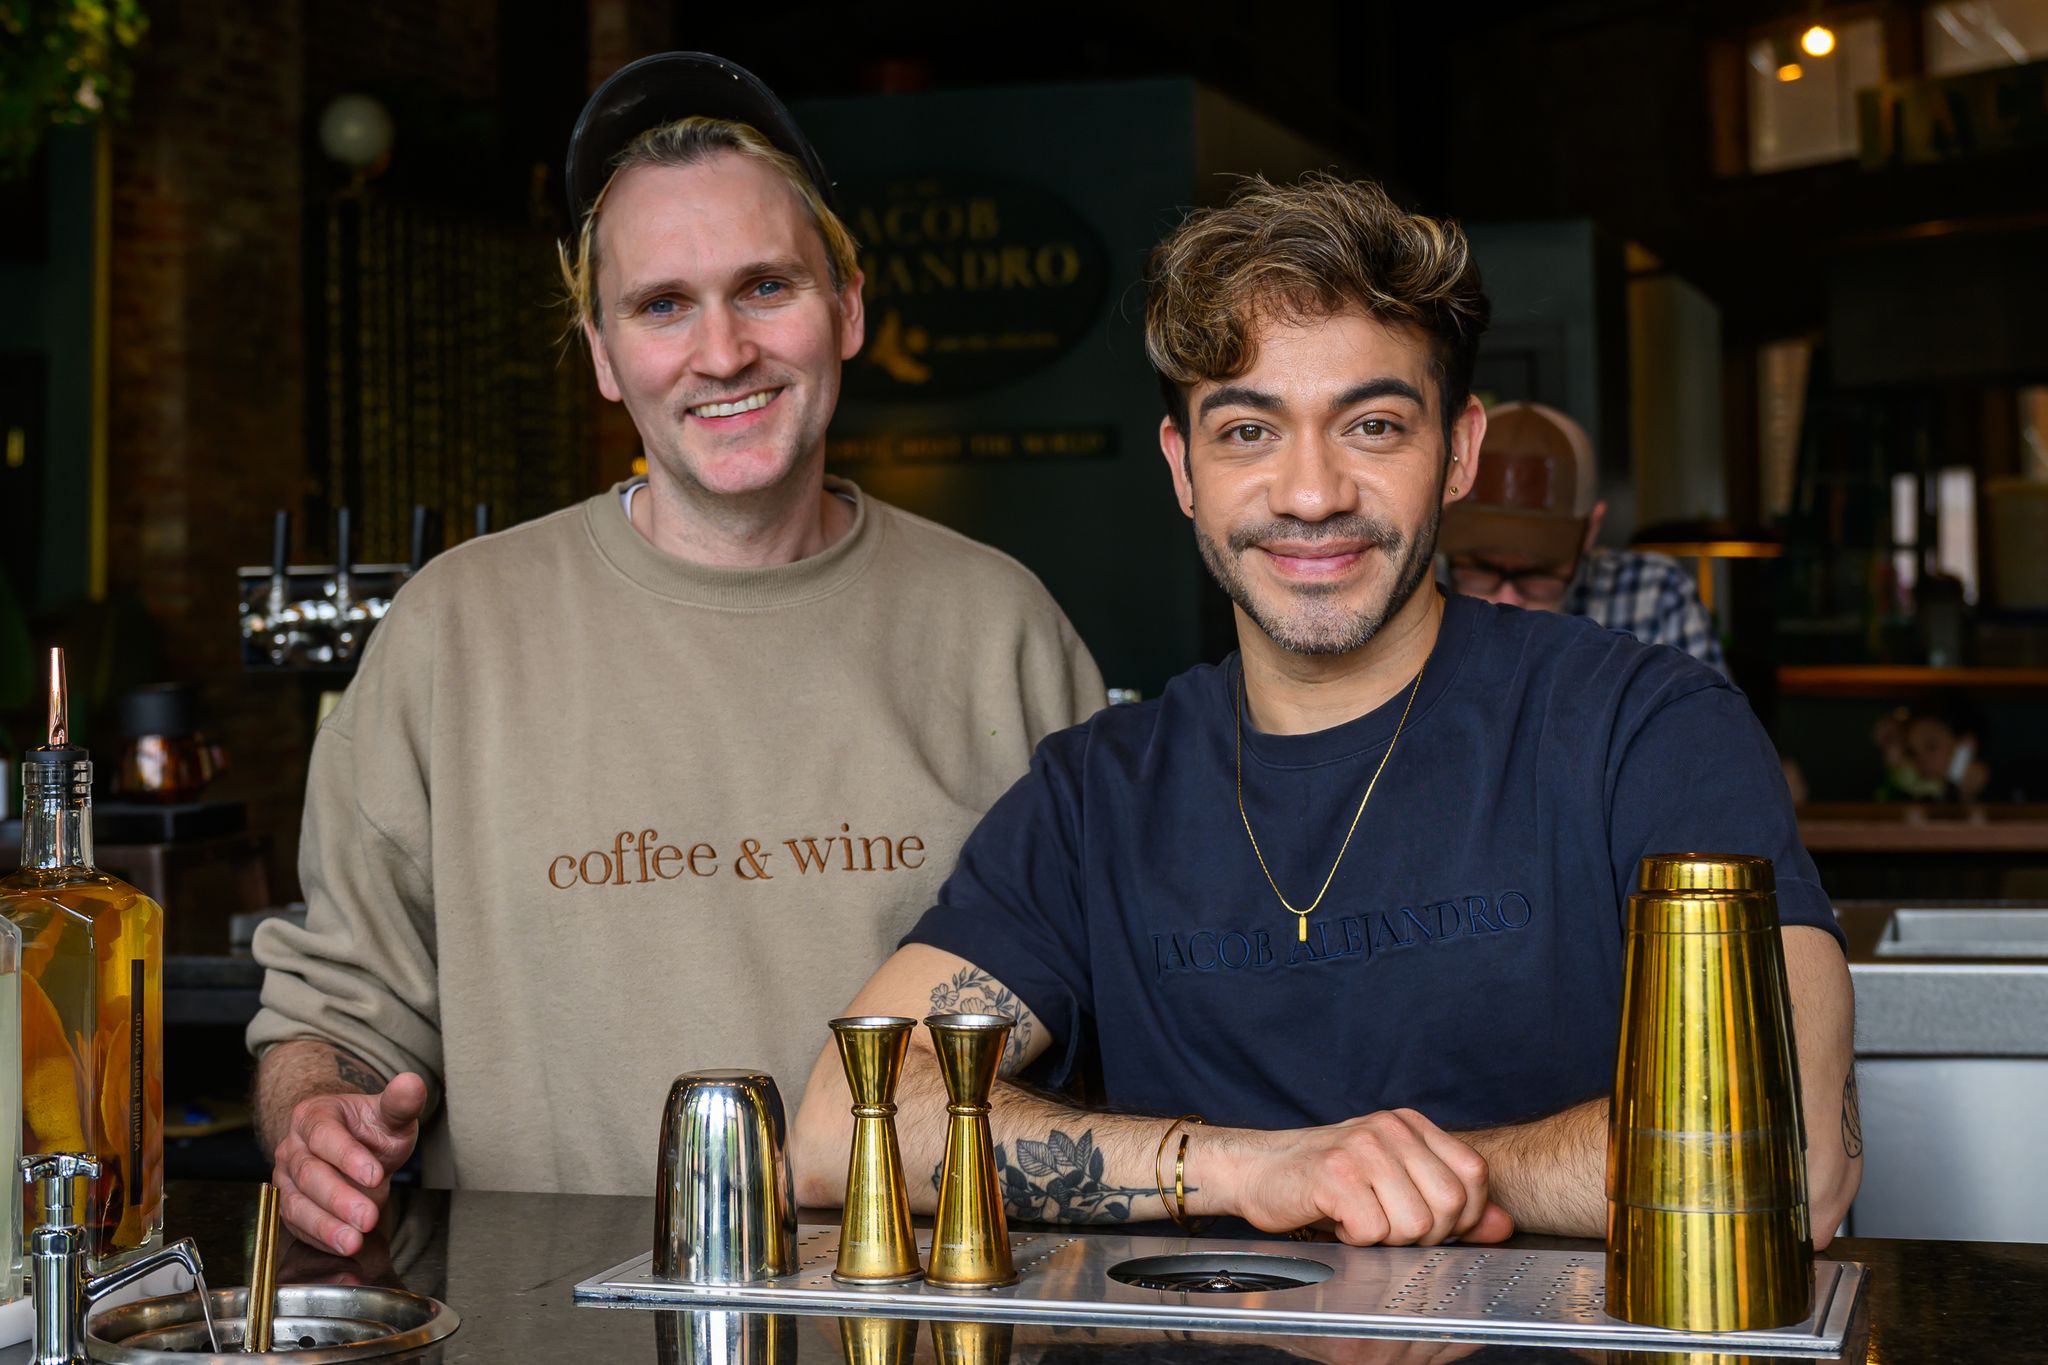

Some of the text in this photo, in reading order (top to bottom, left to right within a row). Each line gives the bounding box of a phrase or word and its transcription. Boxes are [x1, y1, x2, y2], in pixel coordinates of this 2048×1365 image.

[857, 194, 999, 245] ACOB
[863, 241, 1080, 301] JANDRO
[549, 822, 926, 889] coffee & wine
[1153, 891, 1531, 979] JACOB ALEJANDRO
[133, 1012, 143, 1151] vanilla bean syrup
